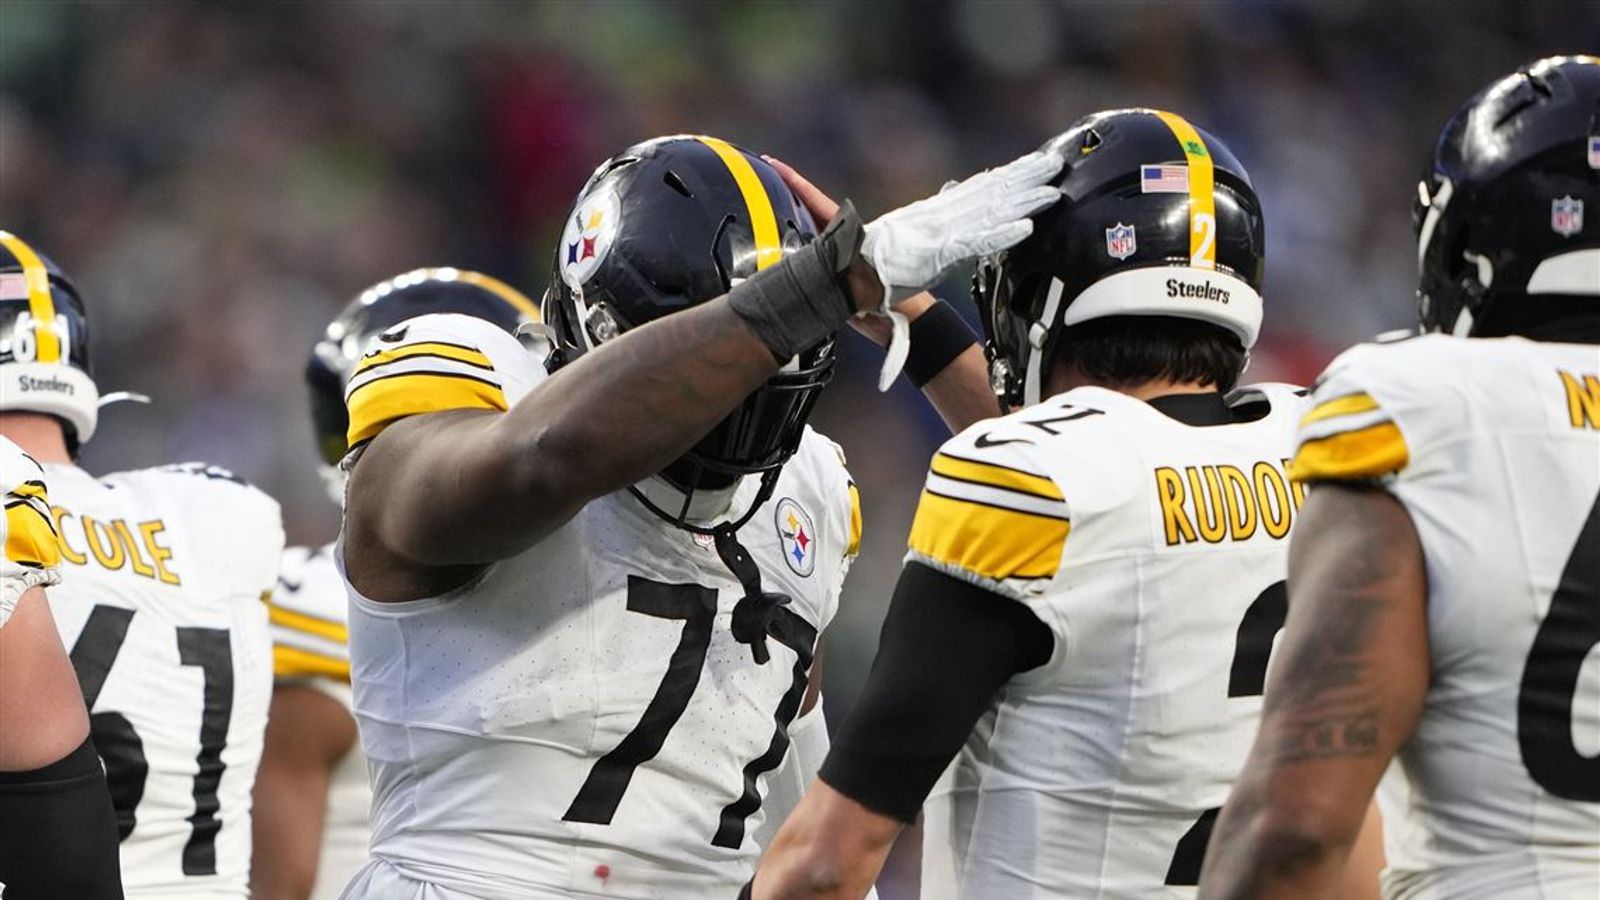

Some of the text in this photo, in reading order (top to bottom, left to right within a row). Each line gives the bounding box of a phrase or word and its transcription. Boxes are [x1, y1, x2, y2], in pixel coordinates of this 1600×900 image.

[1110, 237, 1134, 254] NFL
[1191, 213, 1216, 268] 2
[1166, 278, 1231, 304] Steelers
[13, 310, 71, 364] 61
[19, 374, 74, 396] Steelers
[51, 505, 181, 586] COLE
[561, 574, 817, 850] 77
[67, 603, 234, 876] 61
